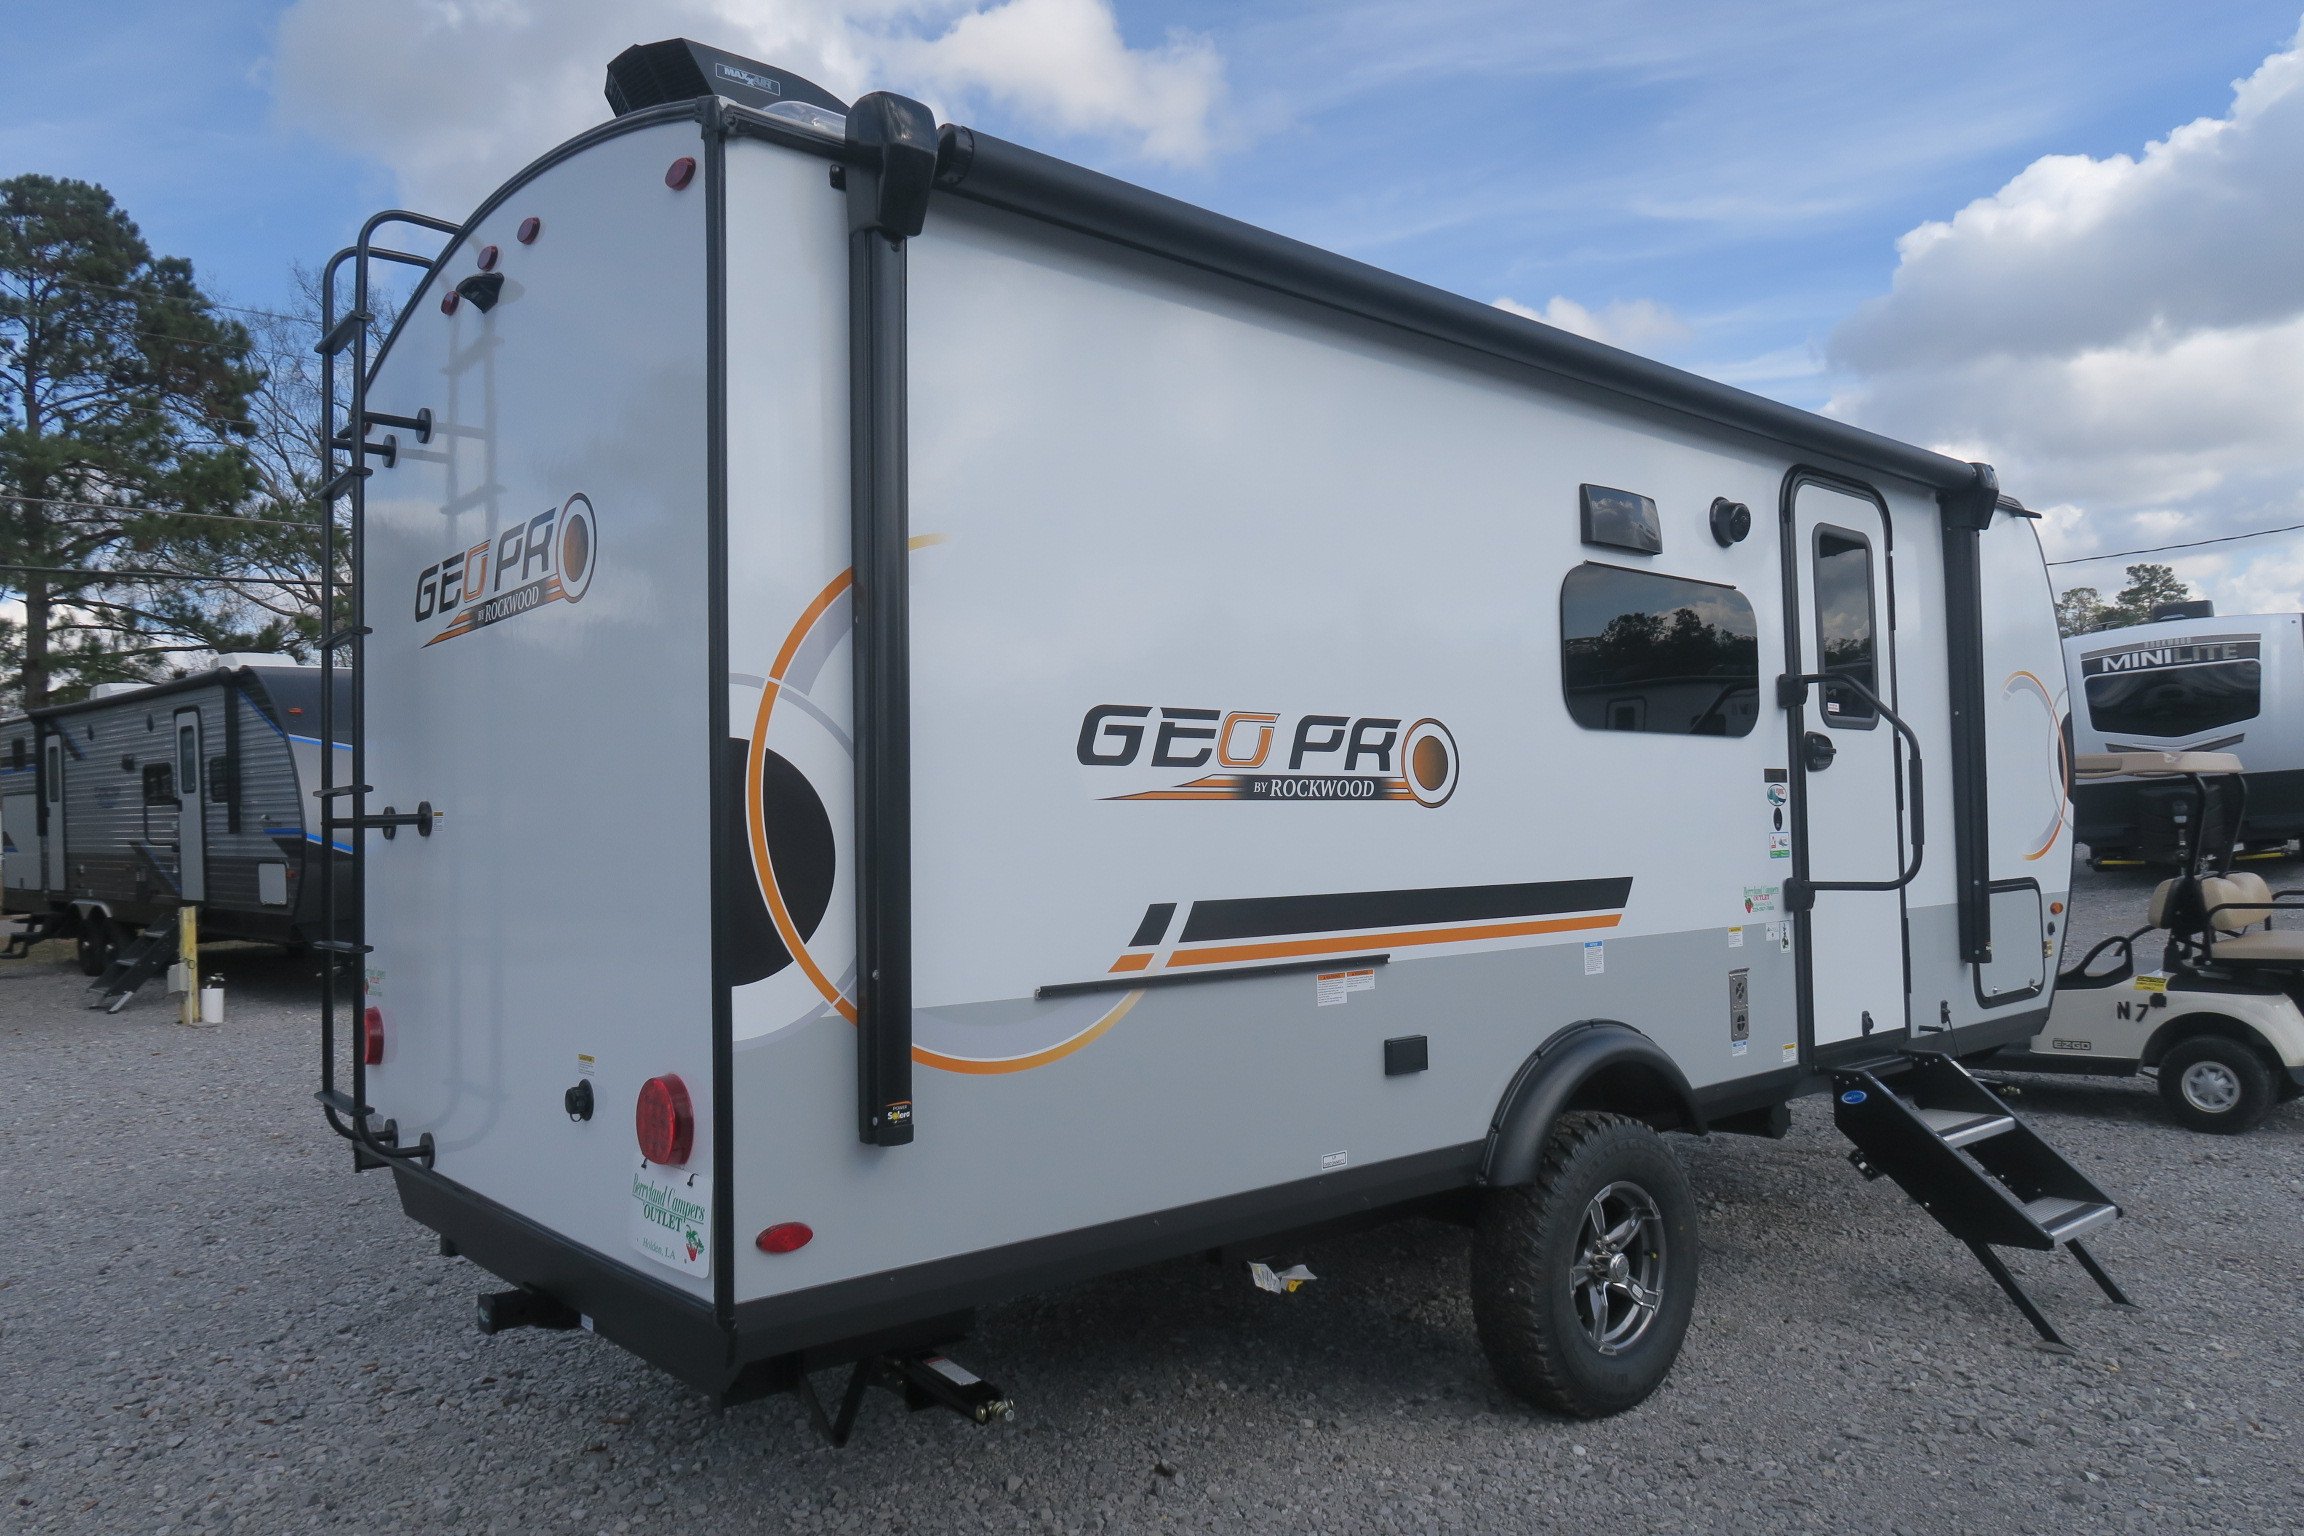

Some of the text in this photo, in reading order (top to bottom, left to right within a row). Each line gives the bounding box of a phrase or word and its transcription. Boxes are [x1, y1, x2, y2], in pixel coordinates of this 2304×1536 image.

[414, 492, 598, 623] GEO PRO
[477, 586, 539, 624] BY ROCKWOOD
[1077, 703, 1460, 808] GEO PRO
[1253, 777, 1375, 798] BY ROCKWOOD
[887, 1110, 911, 1120] Solera
[632, 1172, 706, 1222] Berryland Campers
[643, 1203, 683, 1233] OUTLET
